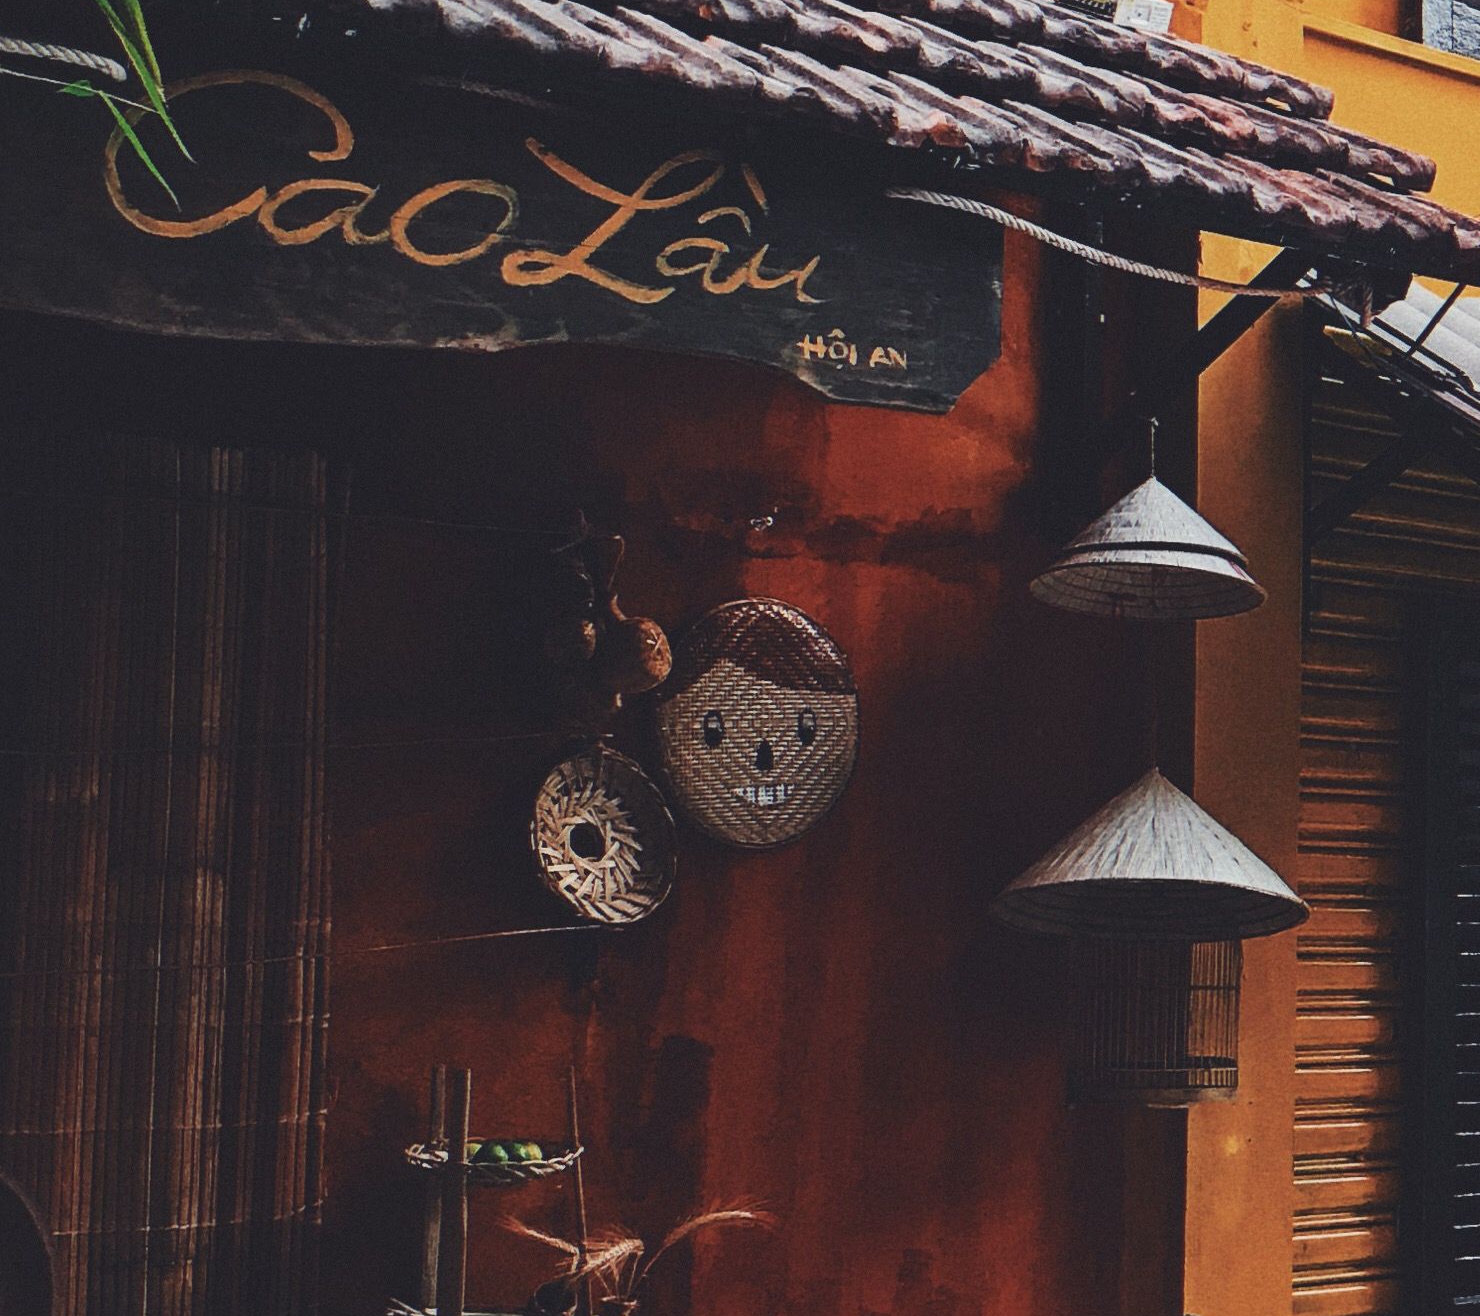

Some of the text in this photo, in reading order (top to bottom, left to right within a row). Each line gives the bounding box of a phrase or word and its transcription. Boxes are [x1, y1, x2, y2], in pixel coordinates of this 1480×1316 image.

[105, 69, 519, 267] Cao
[796, 328, 907, 370] HỘI AN
